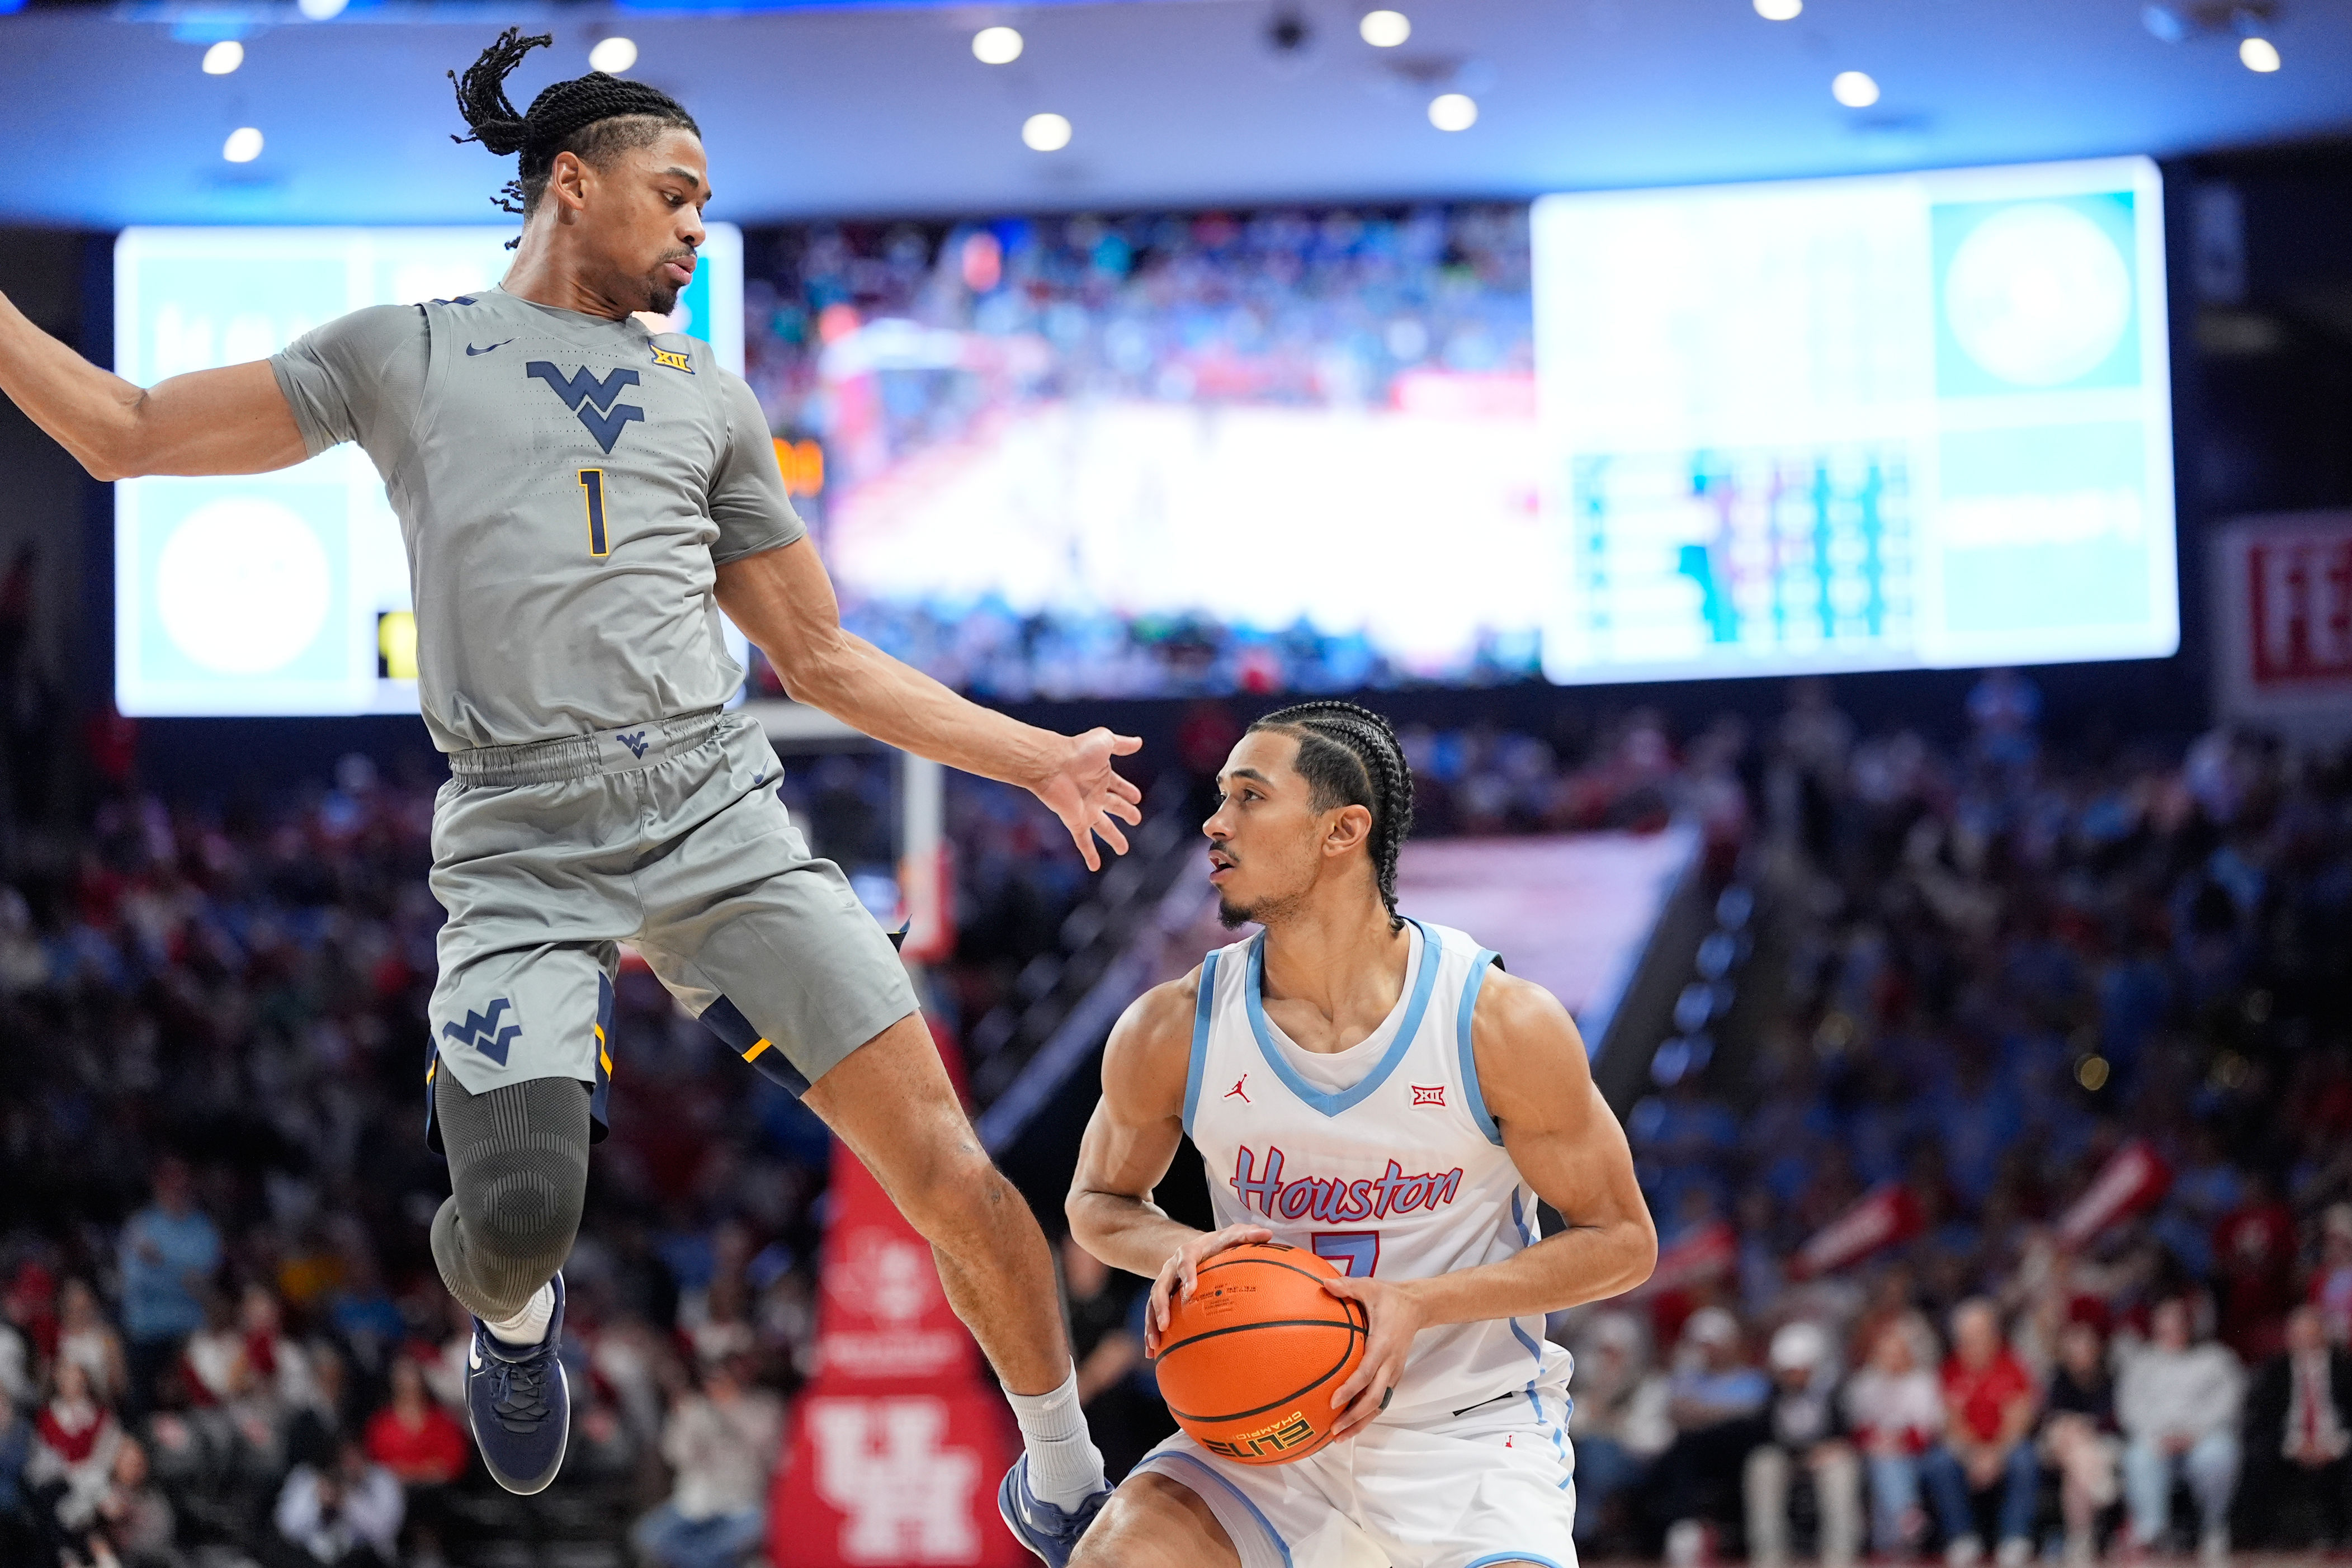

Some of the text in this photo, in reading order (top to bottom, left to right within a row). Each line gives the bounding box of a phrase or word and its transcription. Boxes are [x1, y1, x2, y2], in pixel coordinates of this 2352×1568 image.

[578, 468, 610, 556] 1
[1412, 1084, 1447, 1107] XII
[1230, 1145, 1463, 1224] Houston
[1311, 1231, 1380, 1278] 7
[1201, 1418, 1316, 1457] ELITE
